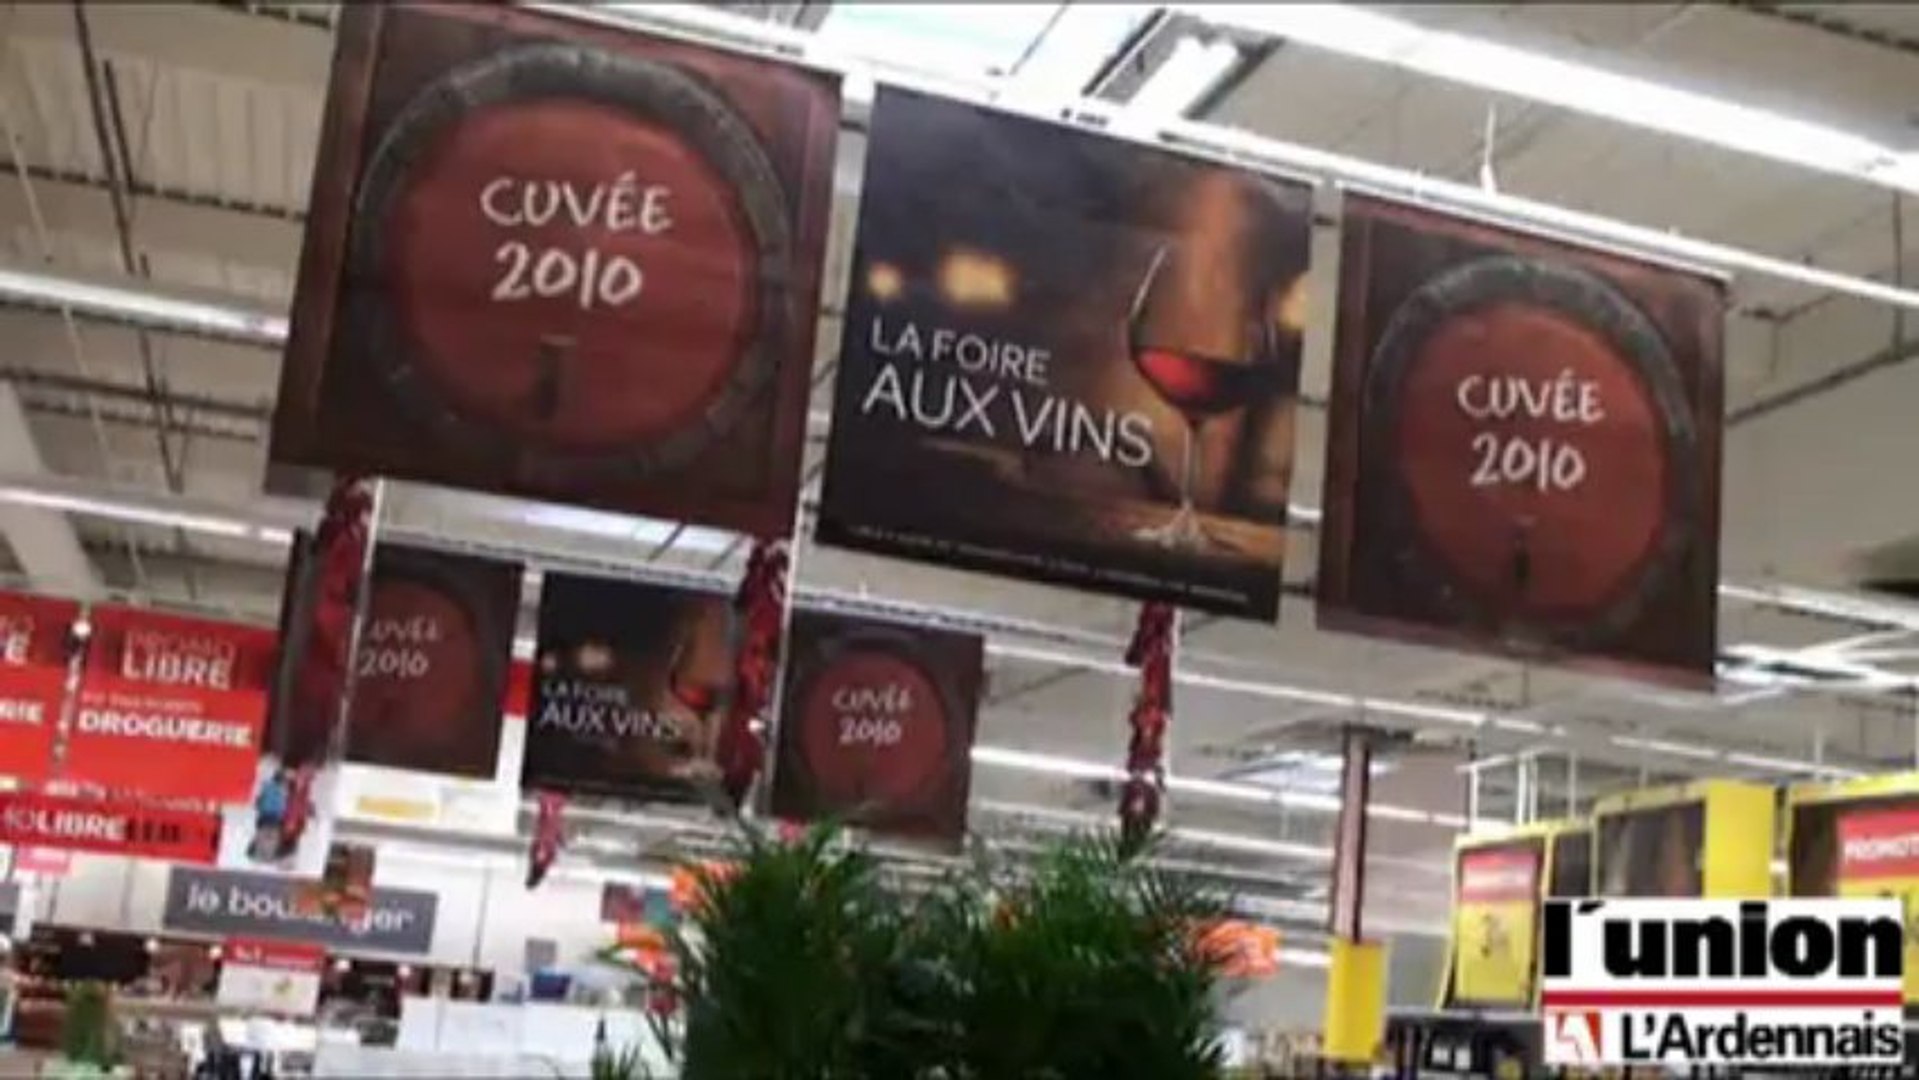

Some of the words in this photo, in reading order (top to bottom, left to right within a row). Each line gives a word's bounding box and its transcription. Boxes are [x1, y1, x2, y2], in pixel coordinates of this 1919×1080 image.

[480, 169, 674, 234] CUVÉE
[492, 241, 643, 310] 2010
[870, 314, 923, 362] LA
[931, 327, 1051, 386] FOIRE
[861, 362, 1000, 438] AUX
[1010, 388, 1153, 468] VINS
[1457, 367, 1605, 424] CUVÉE
[1470, 431, 1587, 493] 2010
[122, 643, 233, 692] LIBRE
[358, 646, 430, 679] 2010
[78, 708, 253, 749] DROGUERIE
[539, 699, 606, 735] AUX
[610, 707, 683, 741] VINS
[837, 716, 902, 748] 2010
